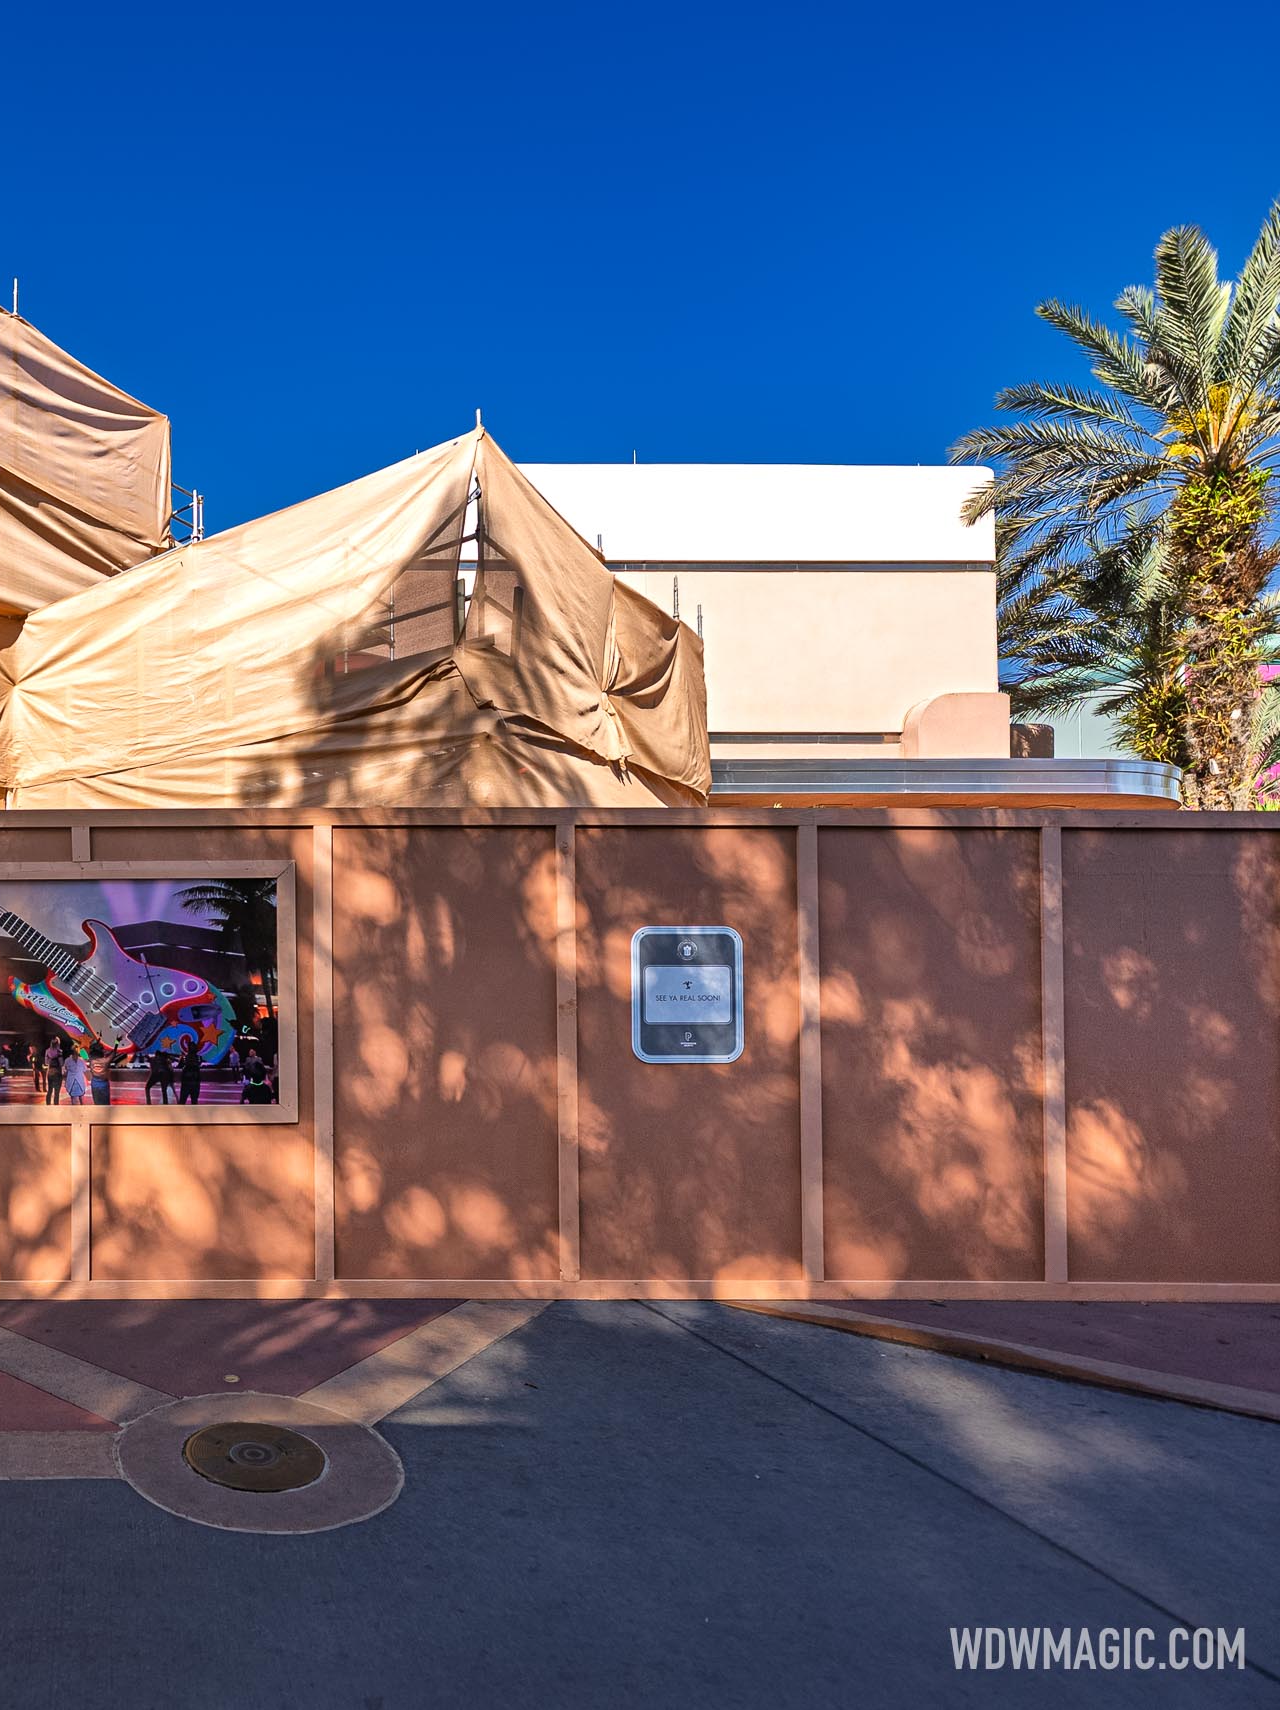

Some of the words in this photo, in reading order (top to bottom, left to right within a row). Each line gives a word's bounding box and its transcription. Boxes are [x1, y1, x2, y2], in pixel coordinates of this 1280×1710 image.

[655, 994, 667, 1002] SEE
[668, 994, 678, 1002] YA
[680, 994, 696, 1002] REAL
[698, 994, 721, 1002] SOON!
